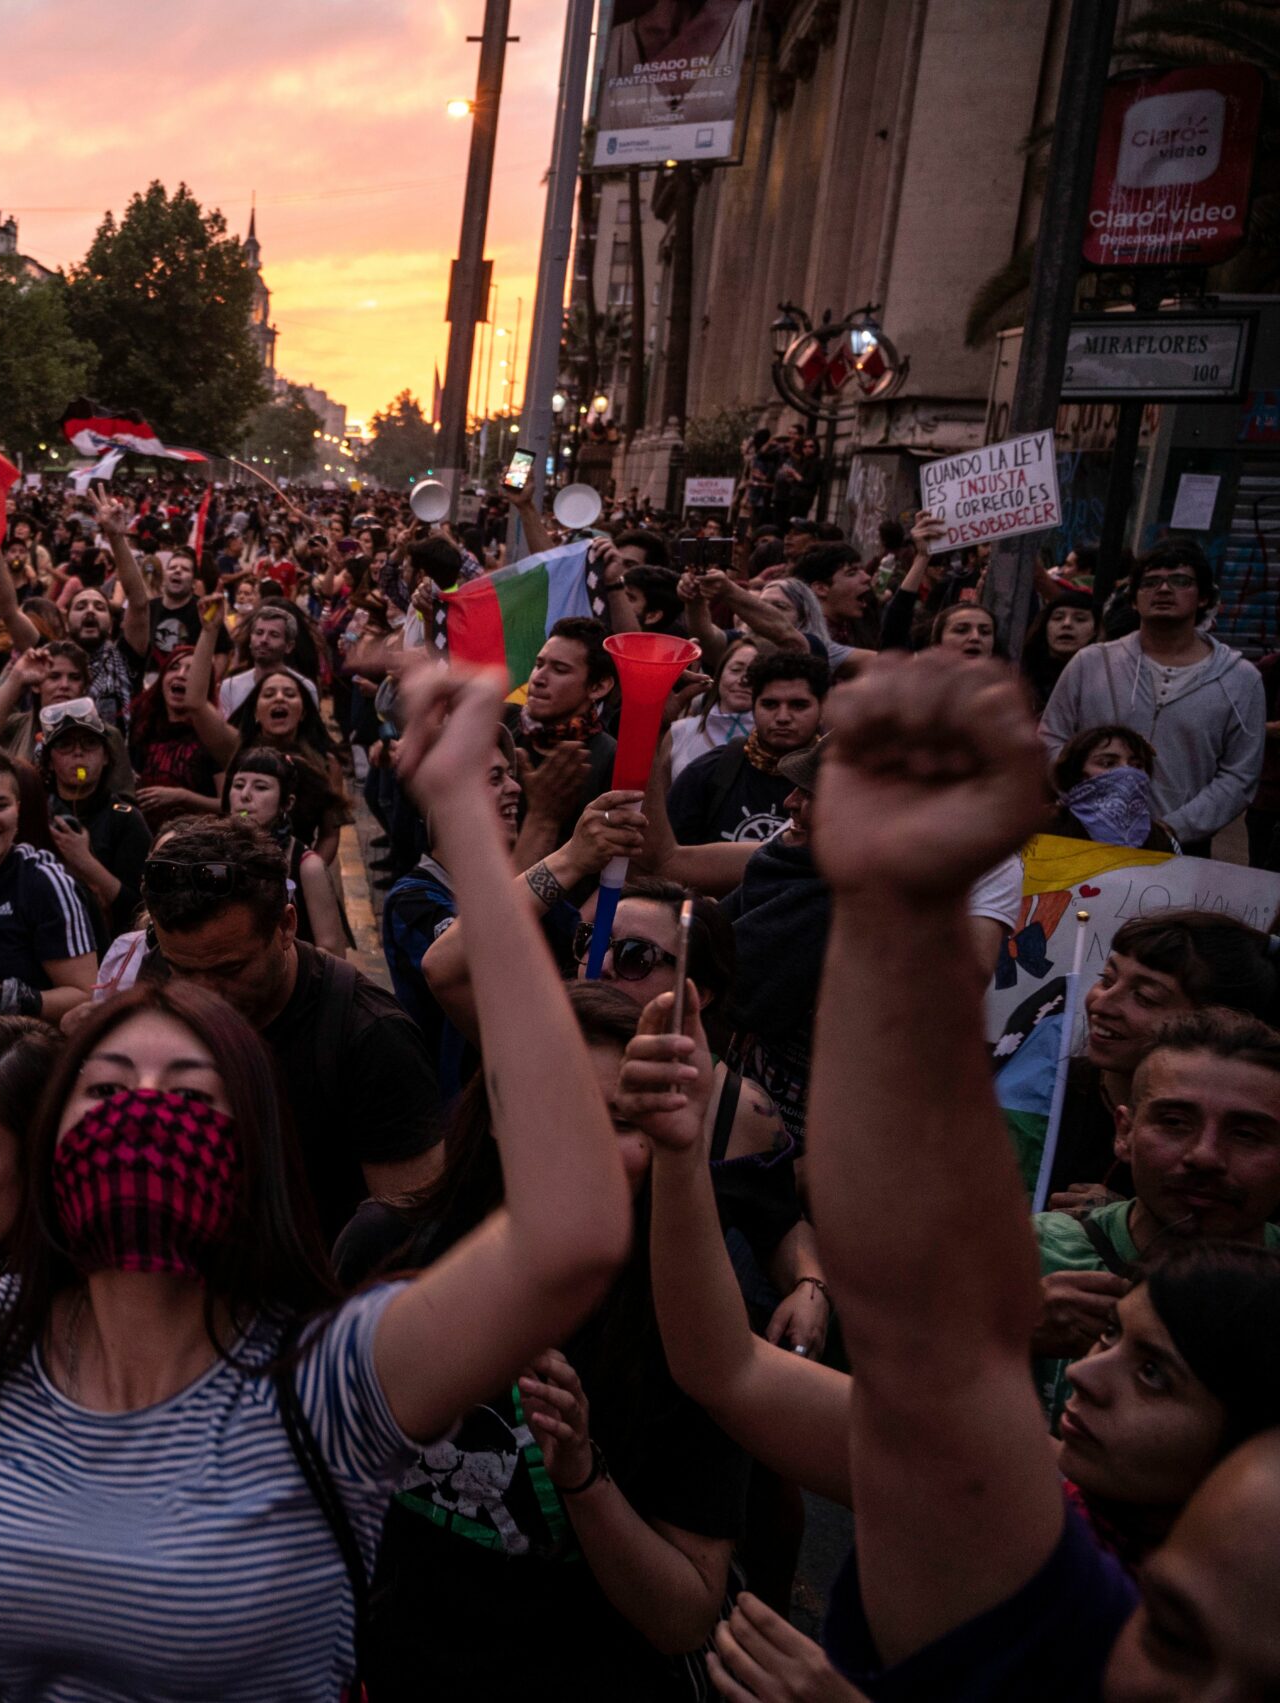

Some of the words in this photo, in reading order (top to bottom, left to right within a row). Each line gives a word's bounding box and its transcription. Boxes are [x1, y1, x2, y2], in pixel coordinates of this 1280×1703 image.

[608, 71, 677, 88] FANTASÍAS
[681, 65, 732, 80] REALES
[632, 58, 687, 74] BASADO
[690, 56, 710, 68] EN
[1131, 126, 1198, 147] Claro
[1159, 144, 1208, 159] video
[1089, 208, 1155, 229] Claro
[1170, 202, 1236, 225] video
[1099, 231, 1166, 247] Descarga
[1169, 231, 1183, 244] la
[1186, 227, 1218, 241] APP
[1083, 334, 1209, 355] MIRAFLORES
[1192, 364, 1220, 382] 100
[925, 453, 982, 488] CUANDO
[989, 447, 1008, 472] LA
[1014, 435, 1046, 467] LEY
[927, 485, 947, 507] ES
[958, 468, 1027, 499] INJUSTA
[955, 488, 1024, 519] CORRECTO
[1028, 483, 1050, 505] ES
[947, 502, 1057, 545] DESOBEDECER
[1114, 879, 1170, 921] LO
